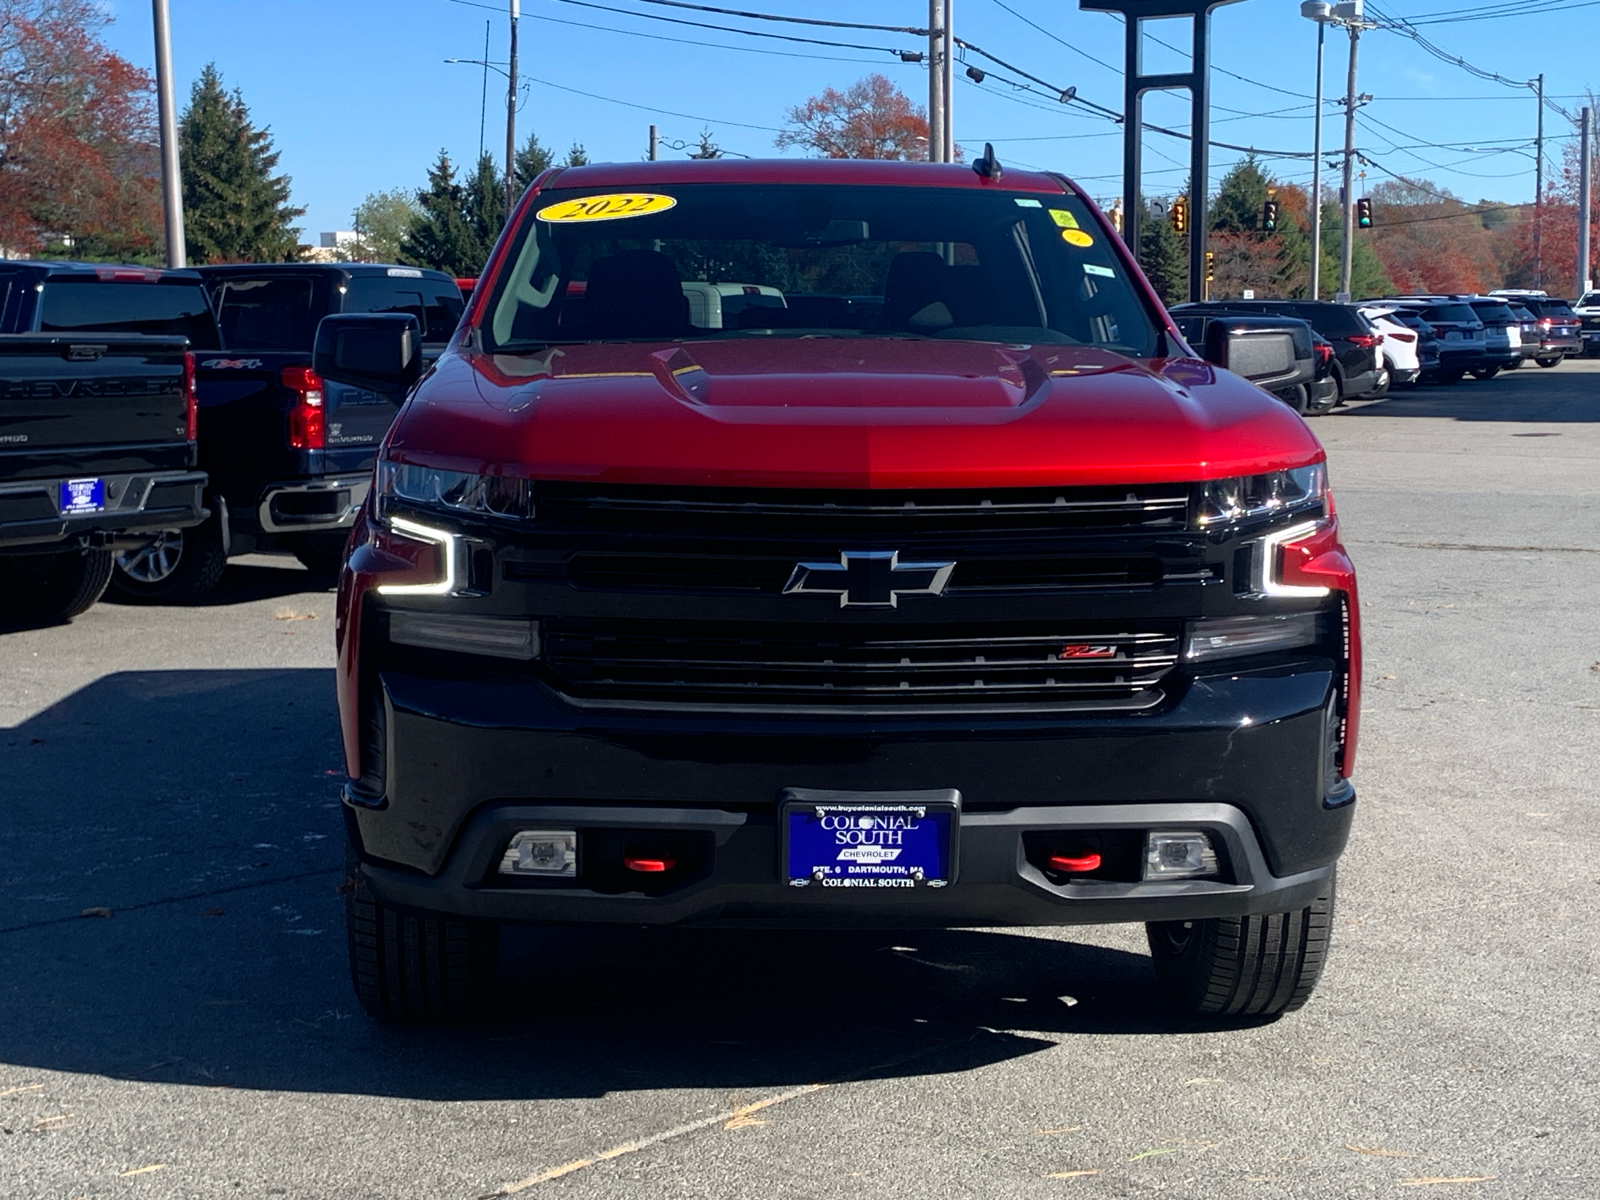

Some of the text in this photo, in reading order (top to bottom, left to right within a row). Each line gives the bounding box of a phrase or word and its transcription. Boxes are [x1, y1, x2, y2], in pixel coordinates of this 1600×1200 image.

[560, 197, 655, 219] 2022
[0, 379, 179, 398] HEVROLET
[820, 815, 919, 830] COLONIAL
[835, 830, 903, 844] SOUTH
[843, 850, 895, 858] CHEVROLET
[834, 866, 841, 874] 6
[848, 866, 908, 875] DARTMOUTH,
[822, 878, 914, 888] COLONIAL SOUTH
